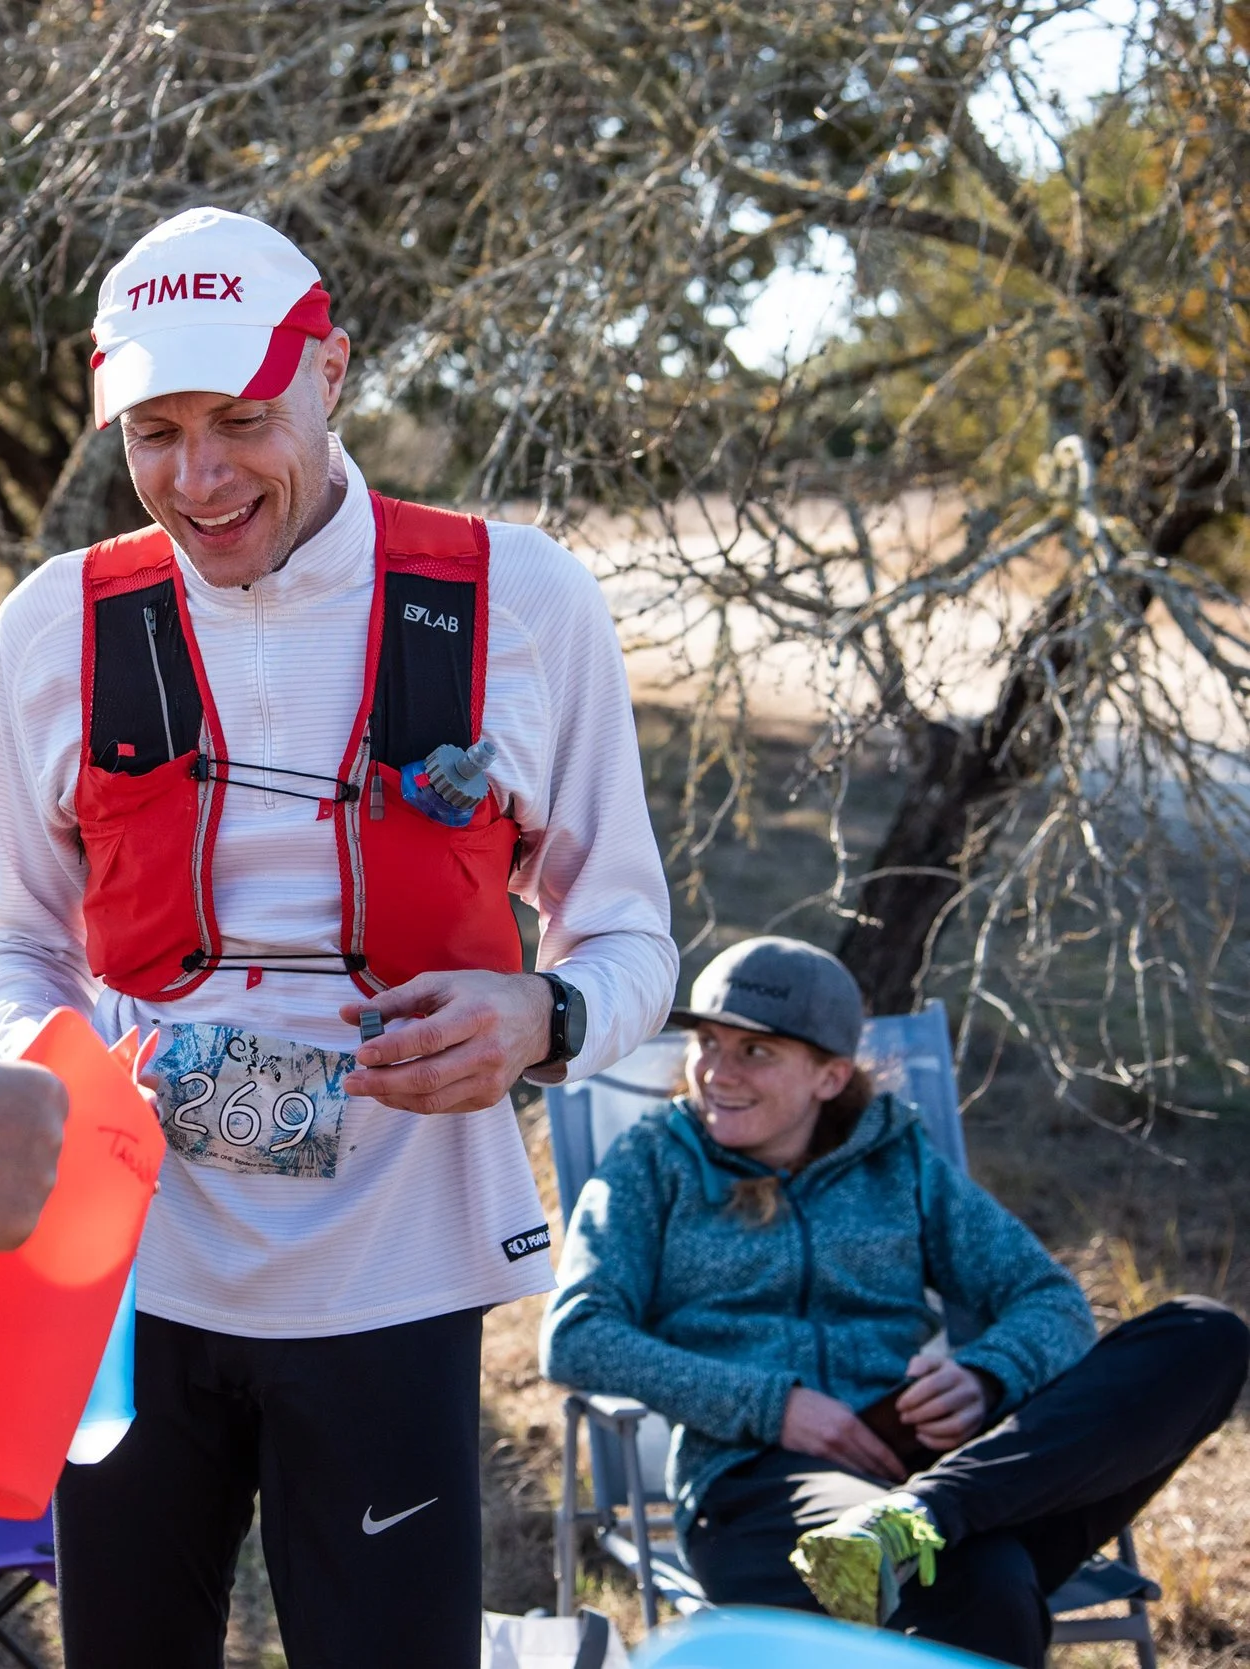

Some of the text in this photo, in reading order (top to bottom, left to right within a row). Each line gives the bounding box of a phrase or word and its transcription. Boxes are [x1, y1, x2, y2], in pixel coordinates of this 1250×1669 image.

[127, 273, 243, 311] TIMEX
[173, 1072, 315, 1153] 269
[220, 1154, 233, 1163] ONE
